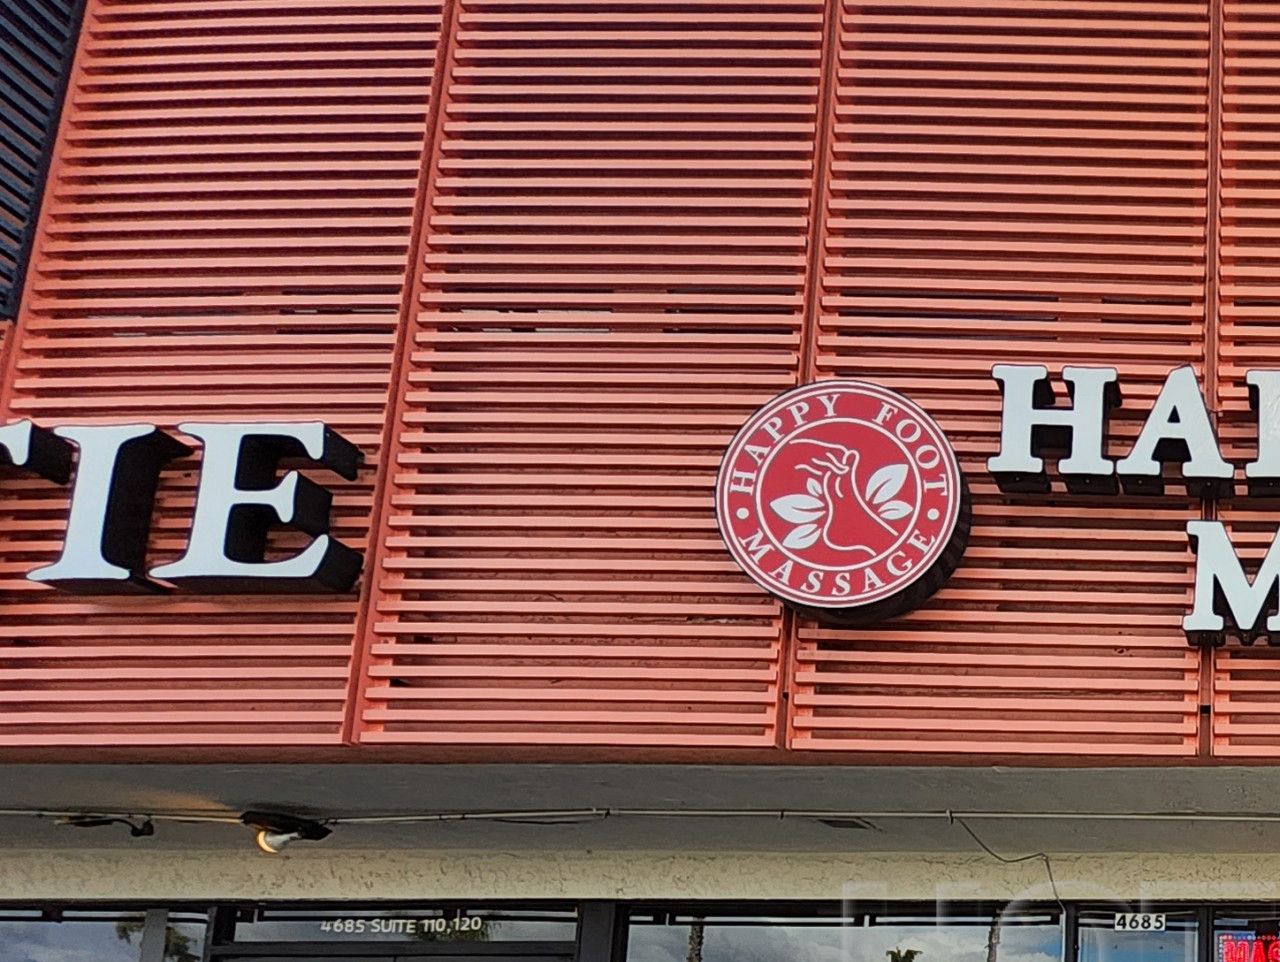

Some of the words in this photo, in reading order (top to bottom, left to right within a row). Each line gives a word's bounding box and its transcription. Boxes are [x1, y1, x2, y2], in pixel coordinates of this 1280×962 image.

[729, 393, 841, 496] HAPPY
[871, 401, 948, 497] FOOT
[738, 527, 937, 596] MASSAGE
[319, 918, 366, 933] 4685
[370, 918, 418, 934] SUITE
[1115, 913, 1165, 930] 4685
